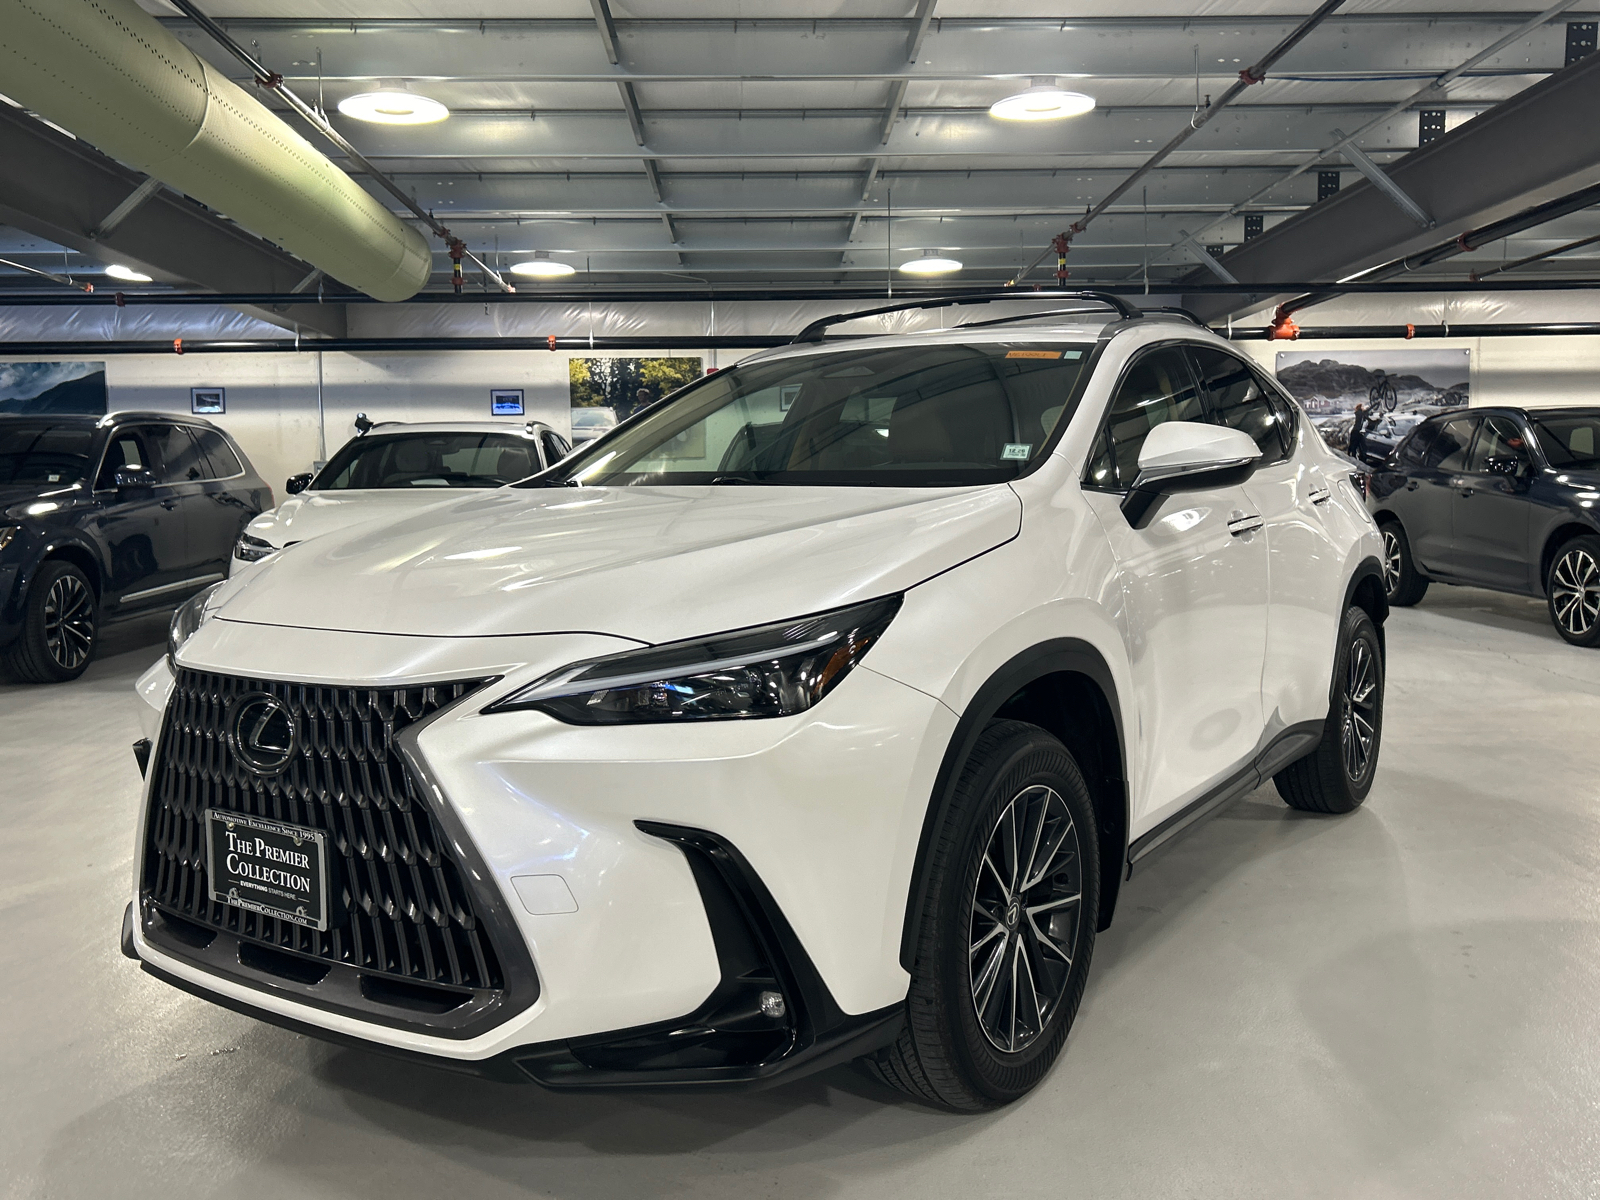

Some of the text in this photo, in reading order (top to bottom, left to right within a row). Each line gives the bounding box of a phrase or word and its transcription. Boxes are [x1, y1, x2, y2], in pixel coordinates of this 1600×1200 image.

[213, 812, 315, 841] AUTOMOTIVE EXCELLENCE SINCE 1995
[225, 831, 310, 869] THE PREMIER
[226, 853, 311, 893] COLLECTION
[240, 880, 268, 892] EVERYTHING
[268, 887, 284, 897] STARTS
[226, 896, 308, 925] THEPREMIERCOLLECTION.COM
